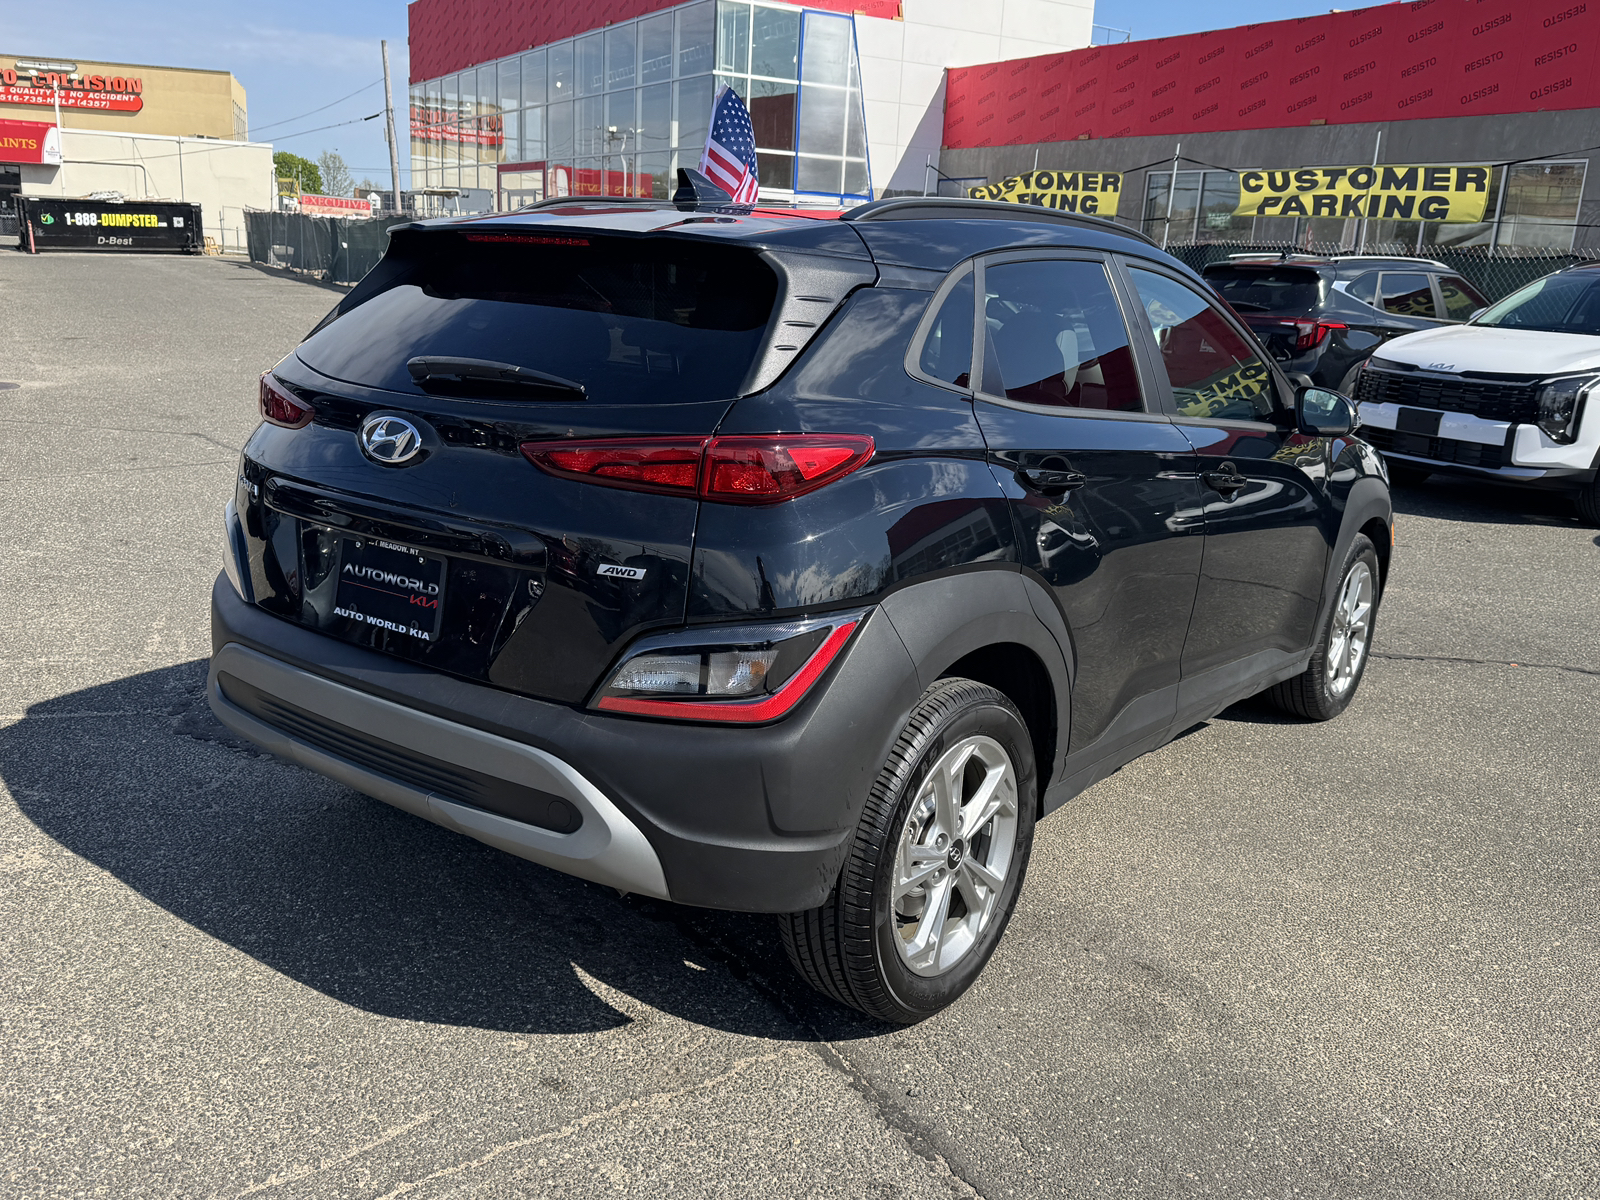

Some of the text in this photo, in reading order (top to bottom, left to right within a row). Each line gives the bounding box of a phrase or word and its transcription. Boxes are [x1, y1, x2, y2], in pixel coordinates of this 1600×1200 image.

[1472, 12, 1513, 37] RESISTO
[1543, 3, 1587, 29] RESISTO
[1349, 26, 1383, 48] RESISTO
[1407, 21, 1445, 44] RESISTO
[1245, 40, 1274, 60] RESISTO
[1294, 33, 1326, 54] RESISTO
[1043, 56, 1064, 73] RESISTO
[1079, 51, 1101, 67] RESISTO
[1116, 53, 1139, 71] RESISTO
[1156, 52, 1181, 69] RESISTO
[1199, 46, 1225, 65] RESISTO
[1464, 51, 1504, 73] RESISTO
[1534, 43, 1578, 67] RESISTO
[1289, 66, 1321, 86] RESISTO
[1343, 61, 1377, 82] RESISTO
[1401, 57, 1437, 79] RESISTO
[31, 71, 142, 93] COLLISION
[1041, 83, 1062, 98] RESISTO
[1076, 78, 1098, 94] RESISTO
[1152, 81, 1176, 98] RESISTO
[1194, 76, 1220, 95] RESISTO
[1241, 71, 1269, 91] RESISTO
[1529, 77, 1573, 100] RESISTO
[10, 86, 51, 96] QUALITY
[70, 90, 84, 98] NO
[88, 92, 136, 102] ACCIDENT
[77, 98, 110, 109] (4357)
[1286, 94, 1317, 114] RESISTO
[1339, 91, 1373, 111] RESISTO
[1397, 88, 1433, 109] RESISTO
[1460, 83, 1499, 105] RESISTO
[1040, 106, 1060, 122] RESISTO
[1075, 101, 1096, 118] RESISTO
[1112, 99, 1135, 115] RESISTO
[1150, 106, 1175, 123] RESISTO
[1193, 103, 1219, 121] RESISTO
[1238, 99, 1266, 117] RESISTO
[970, 171, 1121, 200] CUSTOMER
[1242, 166, 1488, 193] CUSTOMER
[302, 195, 367, 210] EXECUTIVE
[1256, 194, 1451, 219] PARKING
[97, 236, 133, 246] D-Best
[342, 562, 439, 595] AUTOWORLD
[602, 566, 638, 577] AWD
[409, 593, 438, 609] KIA
[333, 606, 430, 641] AUTO WORLD KIA
